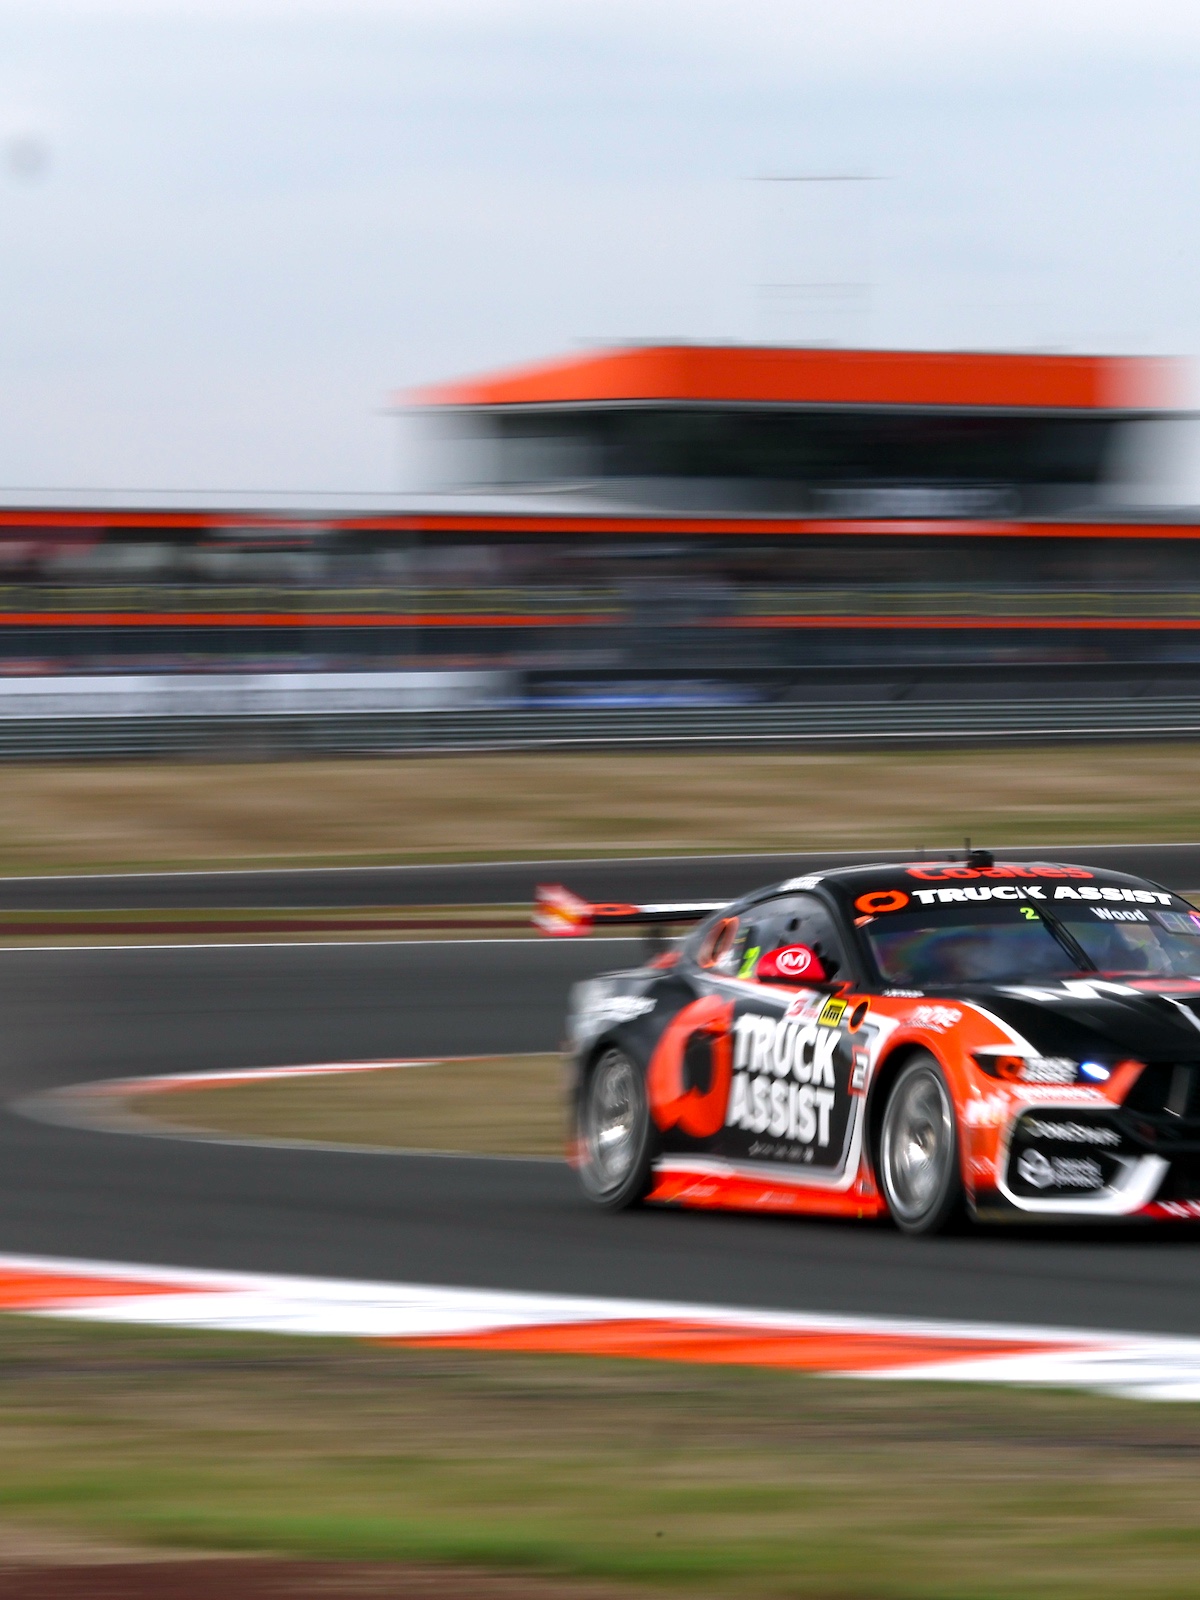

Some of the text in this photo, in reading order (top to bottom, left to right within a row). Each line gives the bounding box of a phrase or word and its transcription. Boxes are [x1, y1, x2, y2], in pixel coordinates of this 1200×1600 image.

[904, 865, 1094, 881] Coates
[912, 886, 1173, 906] TRUCK ASSIST
[1020, 907, 1040, 920] 2
[1089, 907, 1149, 922] Wood
[732, 1012, 842, 1088] TRUCK
[851, 1053, 869, 1090] 2
[725, 1071, 836, 1147] ASSIST
